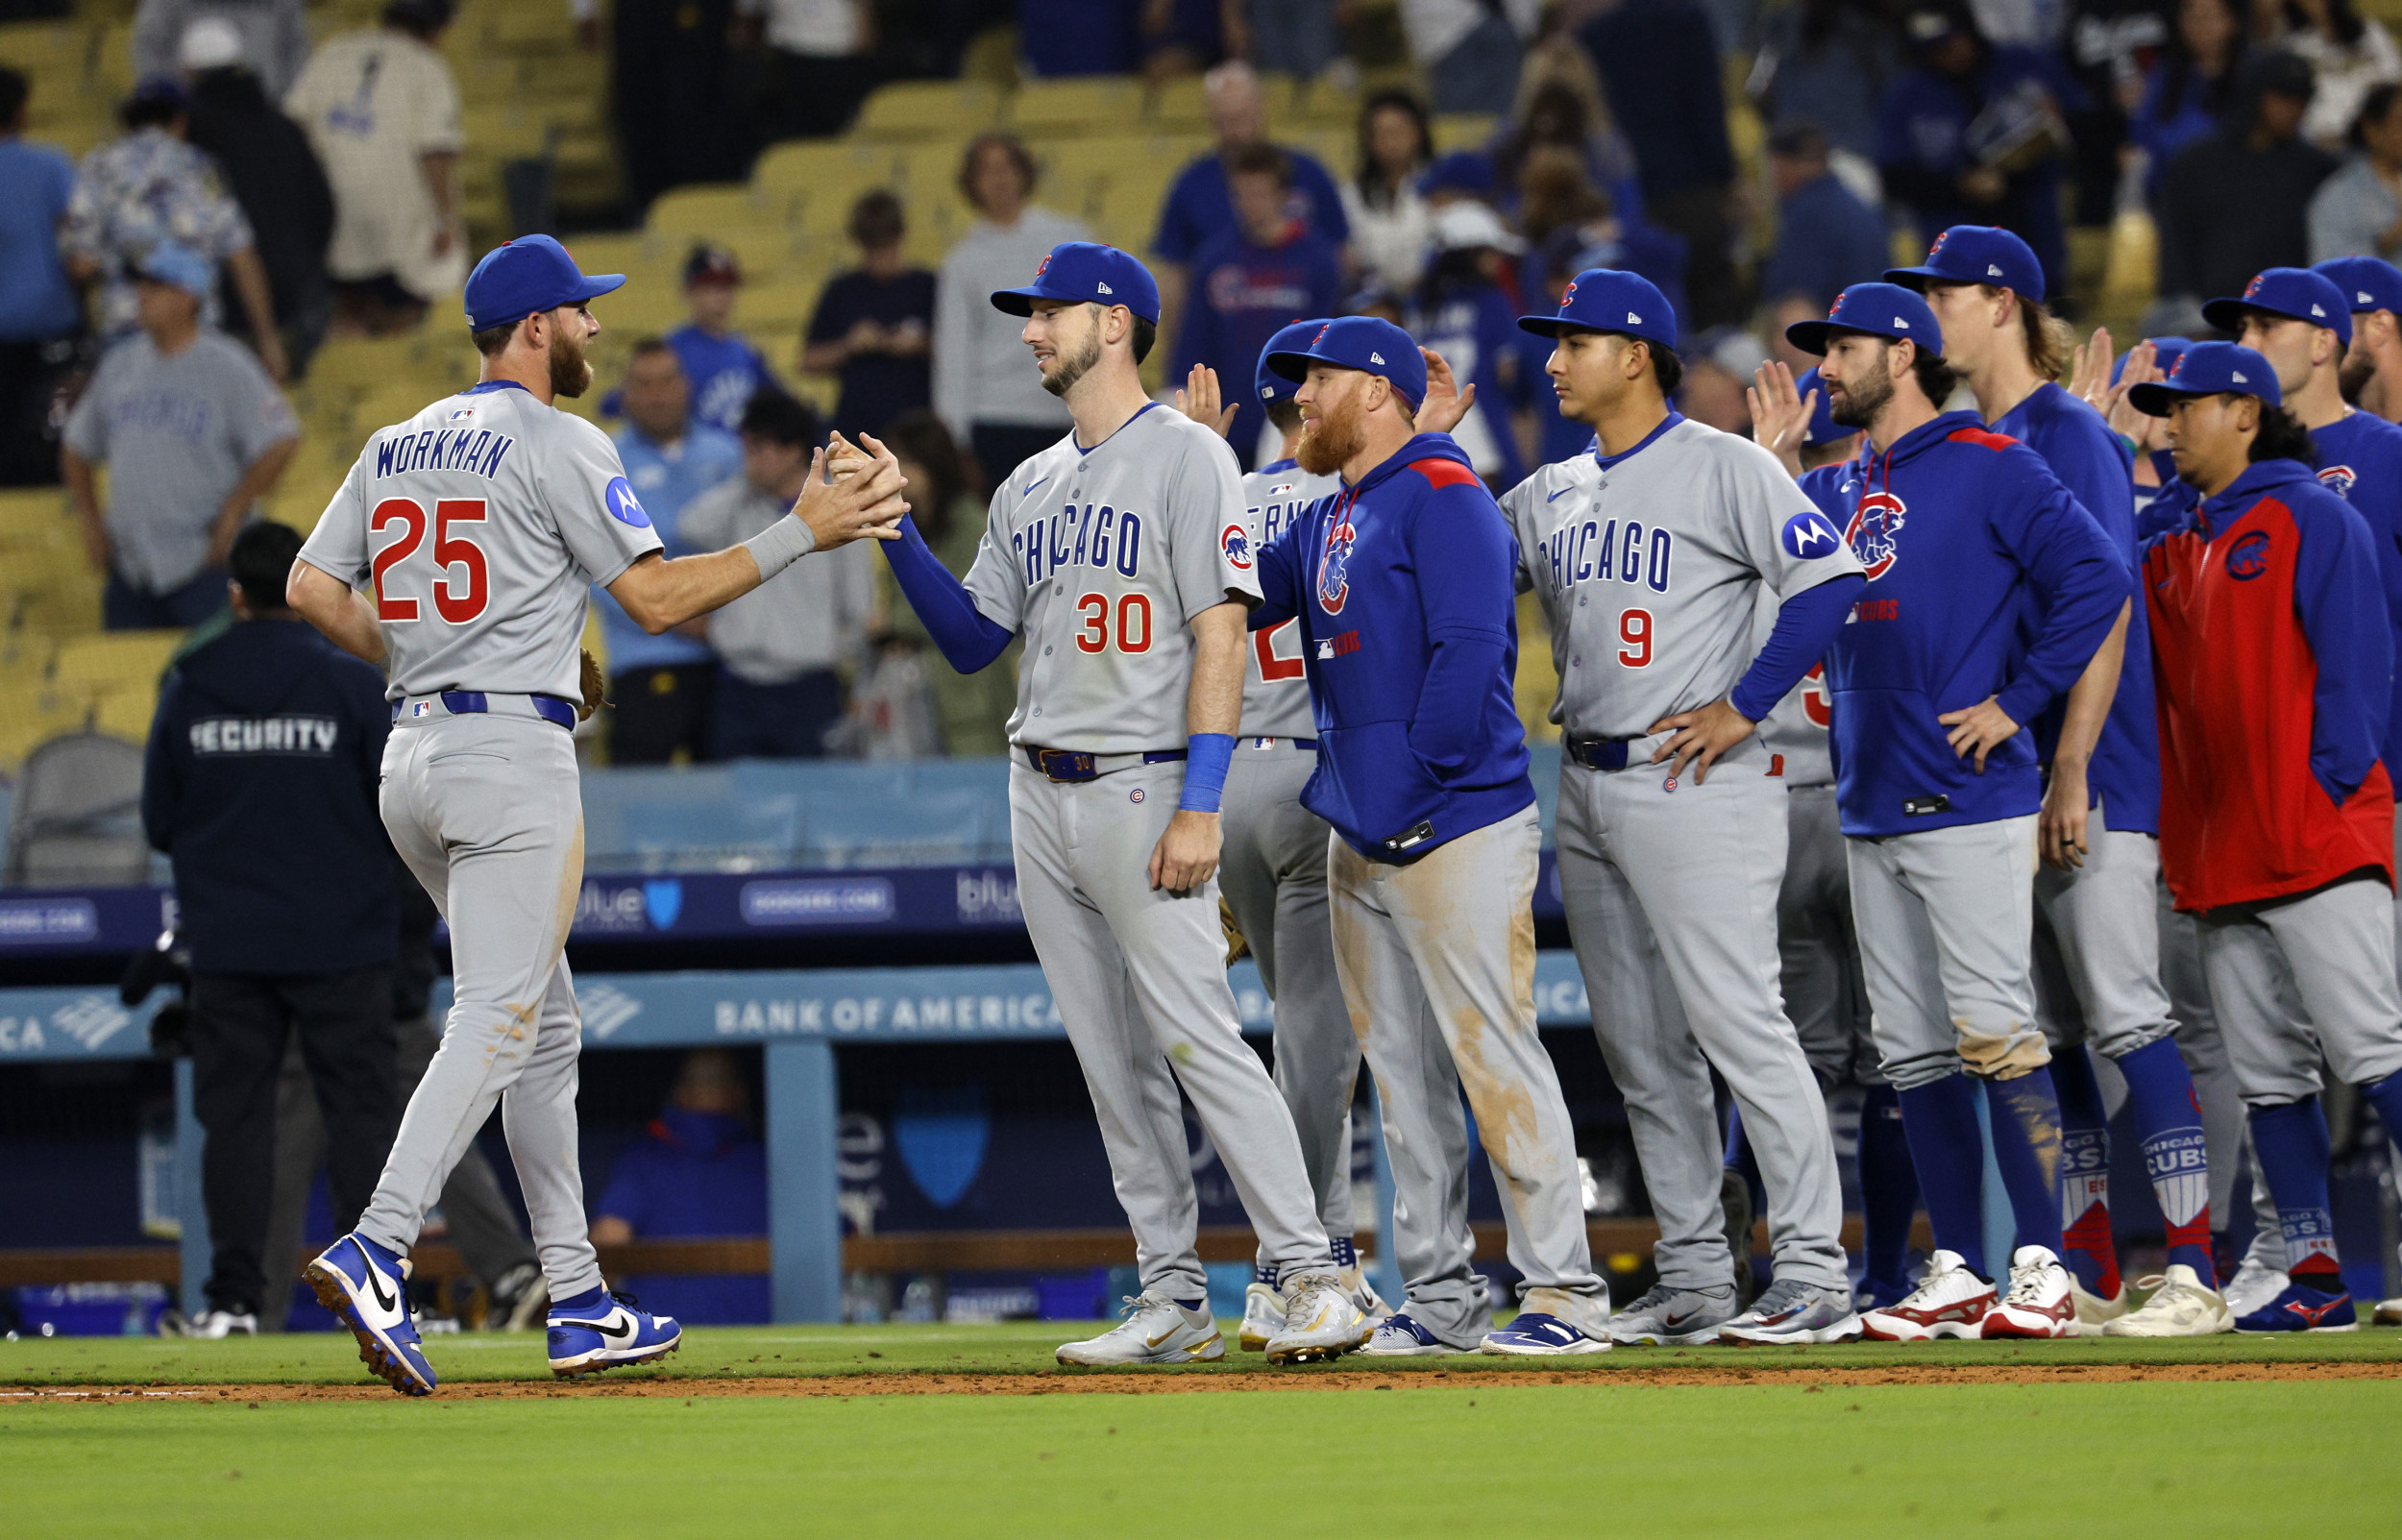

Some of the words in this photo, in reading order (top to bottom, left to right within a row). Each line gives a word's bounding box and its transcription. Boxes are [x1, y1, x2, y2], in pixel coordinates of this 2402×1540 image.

[375, 428, 516, 480] WORKMAN
[369, 496, 491, 626] 25
[1012, 502, 1142, 589] CHICAGO
[1537, 517, 1674, 603] CHICAGO
[1074, 591, 1154, 656] 30
[1861, 599, 1900, 623] CUBS
[1336, 629, 1361, 657] CUBS
[1617, 606, 1655, 670] 9
[1074, 755, 1091, 771] 30
[956, 869, 1019, 914] blu
[714, 998, 825, 1036] BANK
[830, 995, 884, 1034] OF
